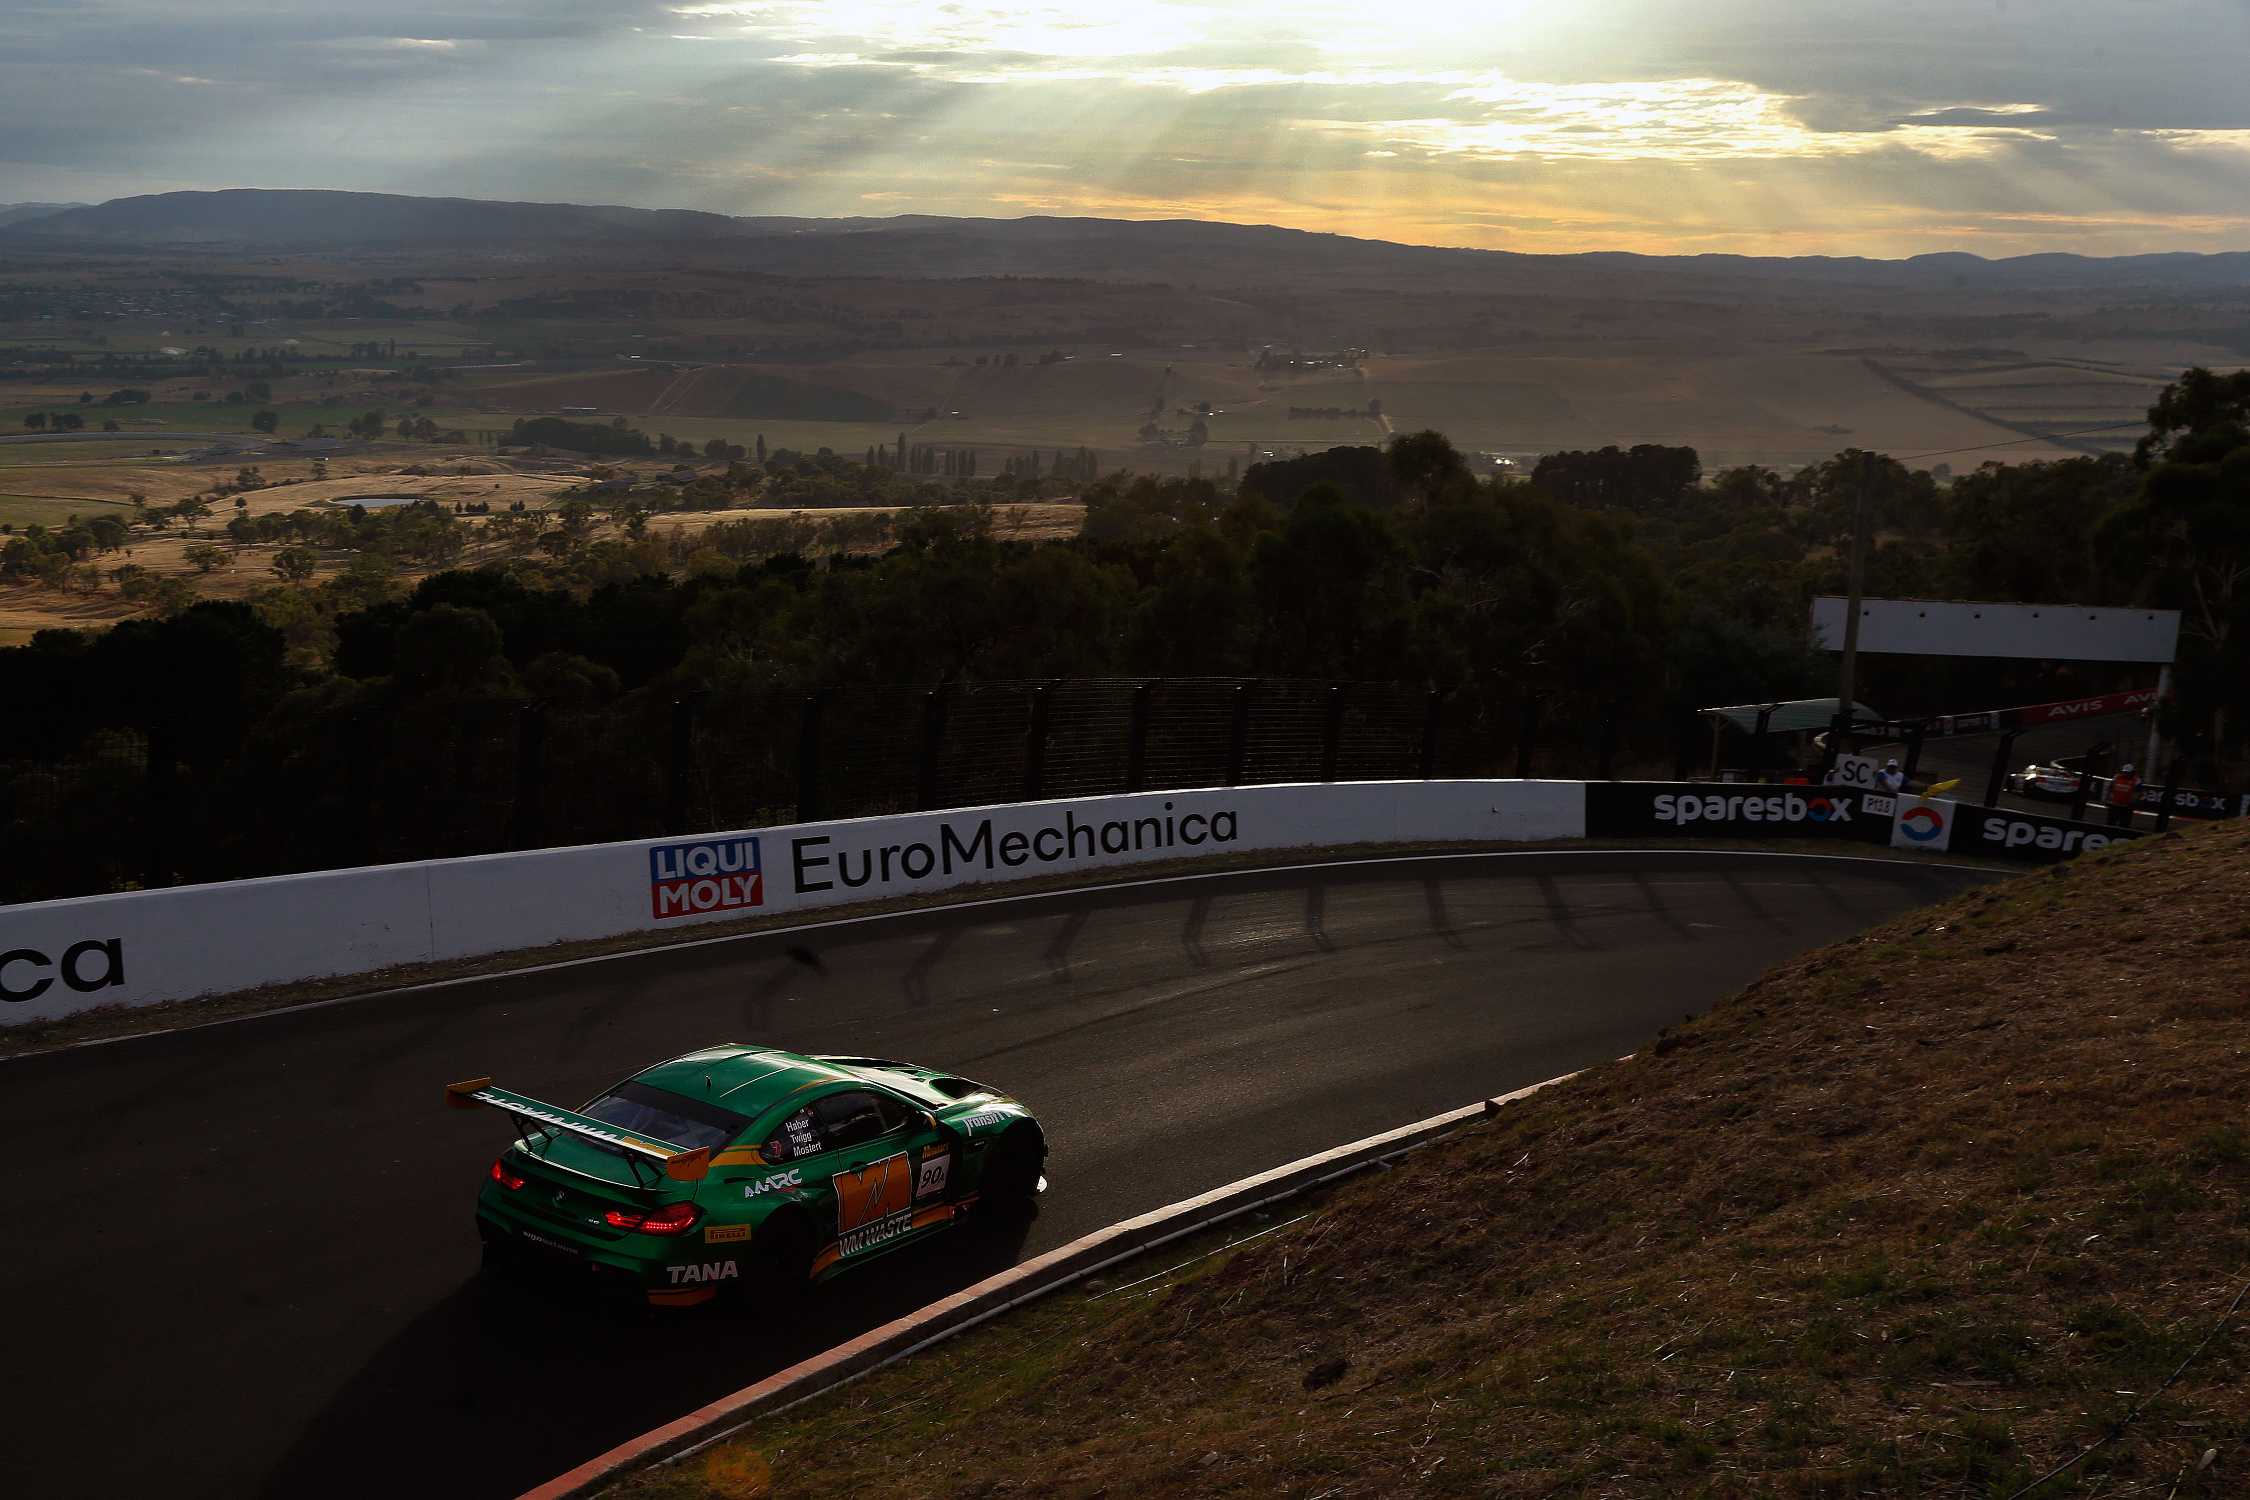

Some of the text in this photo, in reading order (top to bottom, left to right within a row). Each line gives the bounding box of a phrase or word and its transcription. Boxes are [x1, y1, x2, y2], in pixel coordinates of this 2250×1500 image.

[2049, 700, 2105, 717] AVIS
[1842, 760, 1870, 784] SC
[1653, 792, 1853, 826] sparesbox
[656, 842, 755, 880] LIQUI
[792, 803, 1237, 893] EuroMechanica
[660, 874, 759, 914] MOLY
[0, 937, 125, 1002] ca
[785, 1119, 809, 1133] Haber
[790, 1131, 812, 1144] Twigg
[792, 1141, 822, 1157] Mostert
[839, 1211, 913, 1257] WM WASTE
[666, 1260, 739, 1284] TANA
